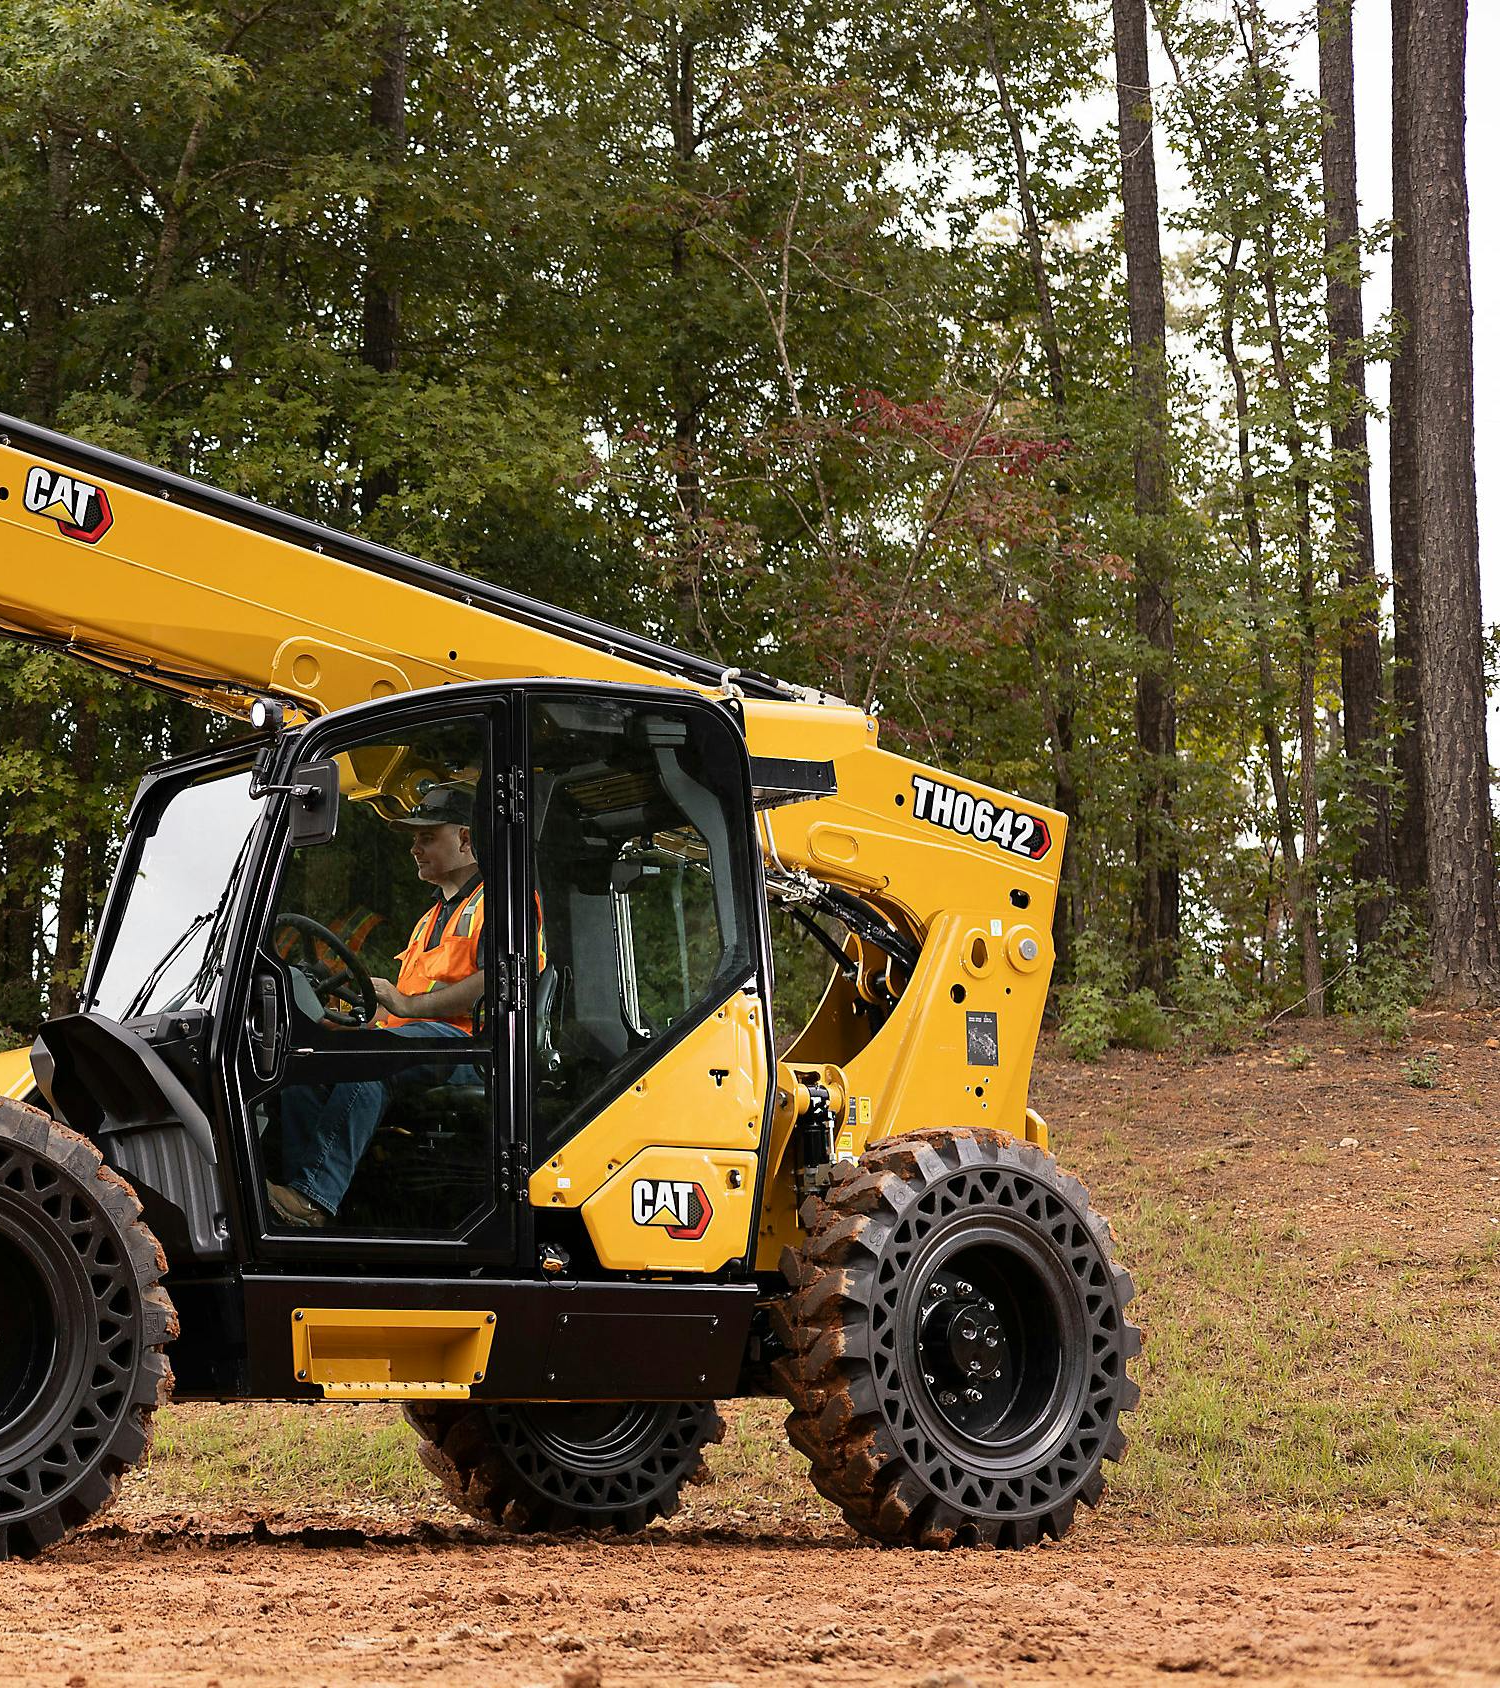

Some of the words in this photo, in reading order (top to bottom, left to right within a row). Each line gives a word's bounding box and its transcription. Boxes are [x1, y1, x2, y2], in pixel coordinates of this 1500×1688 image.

[25, 466, 97, 527] CAT
[913, 776, 1035, 855] TH0642
[632, 1180, 694, 1226] CAT
